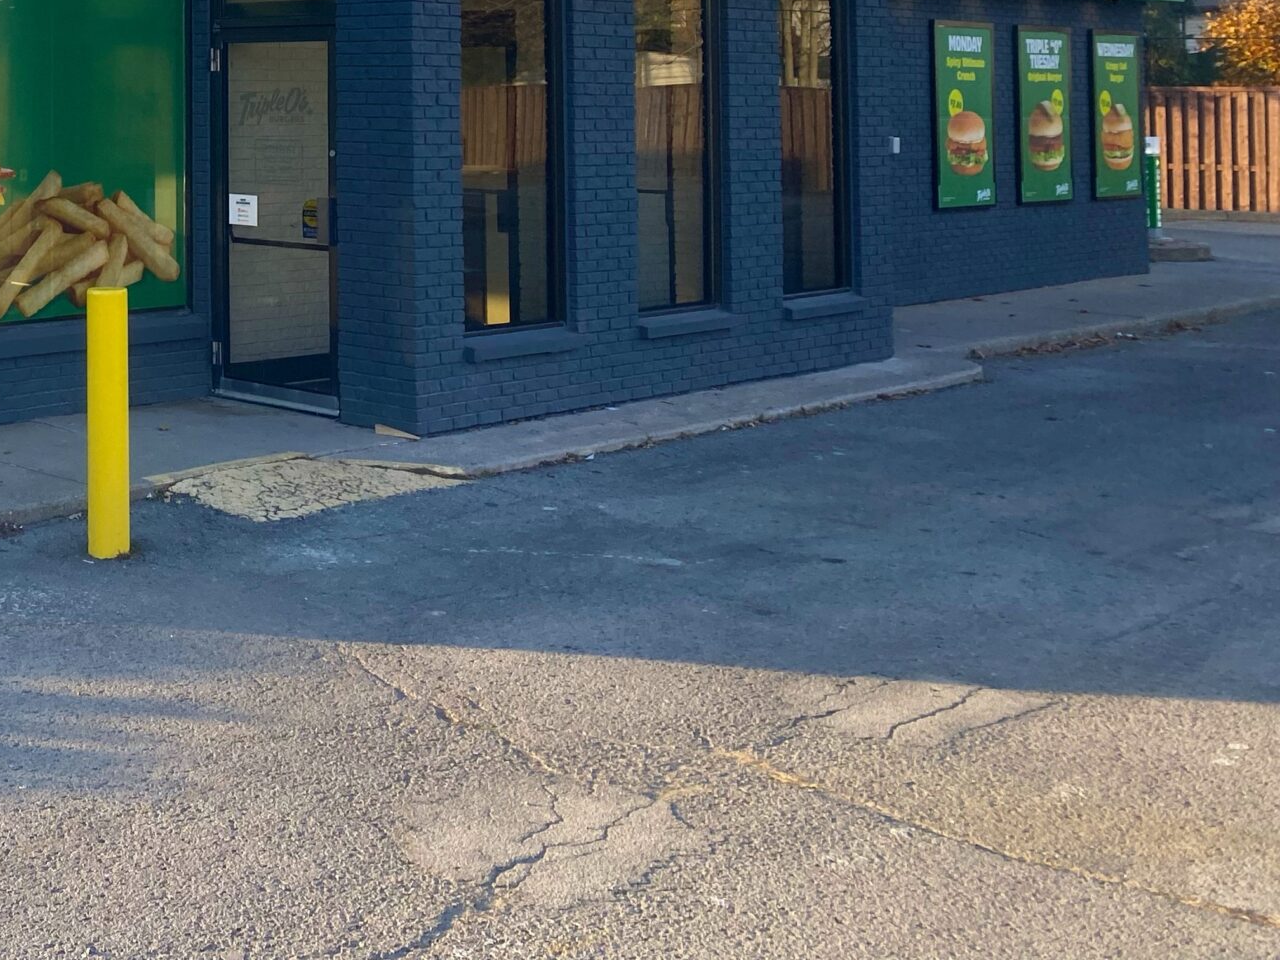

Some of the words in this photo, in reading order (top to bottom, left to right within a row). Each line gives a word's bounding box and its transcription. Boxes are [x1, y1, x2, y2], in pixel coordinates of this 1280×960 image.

[948, 35, 982, 53] MONDAY
[1026, 38, 1048, 54] TRIPLE
[1030, 54, 1060, 69] TUESDAY
